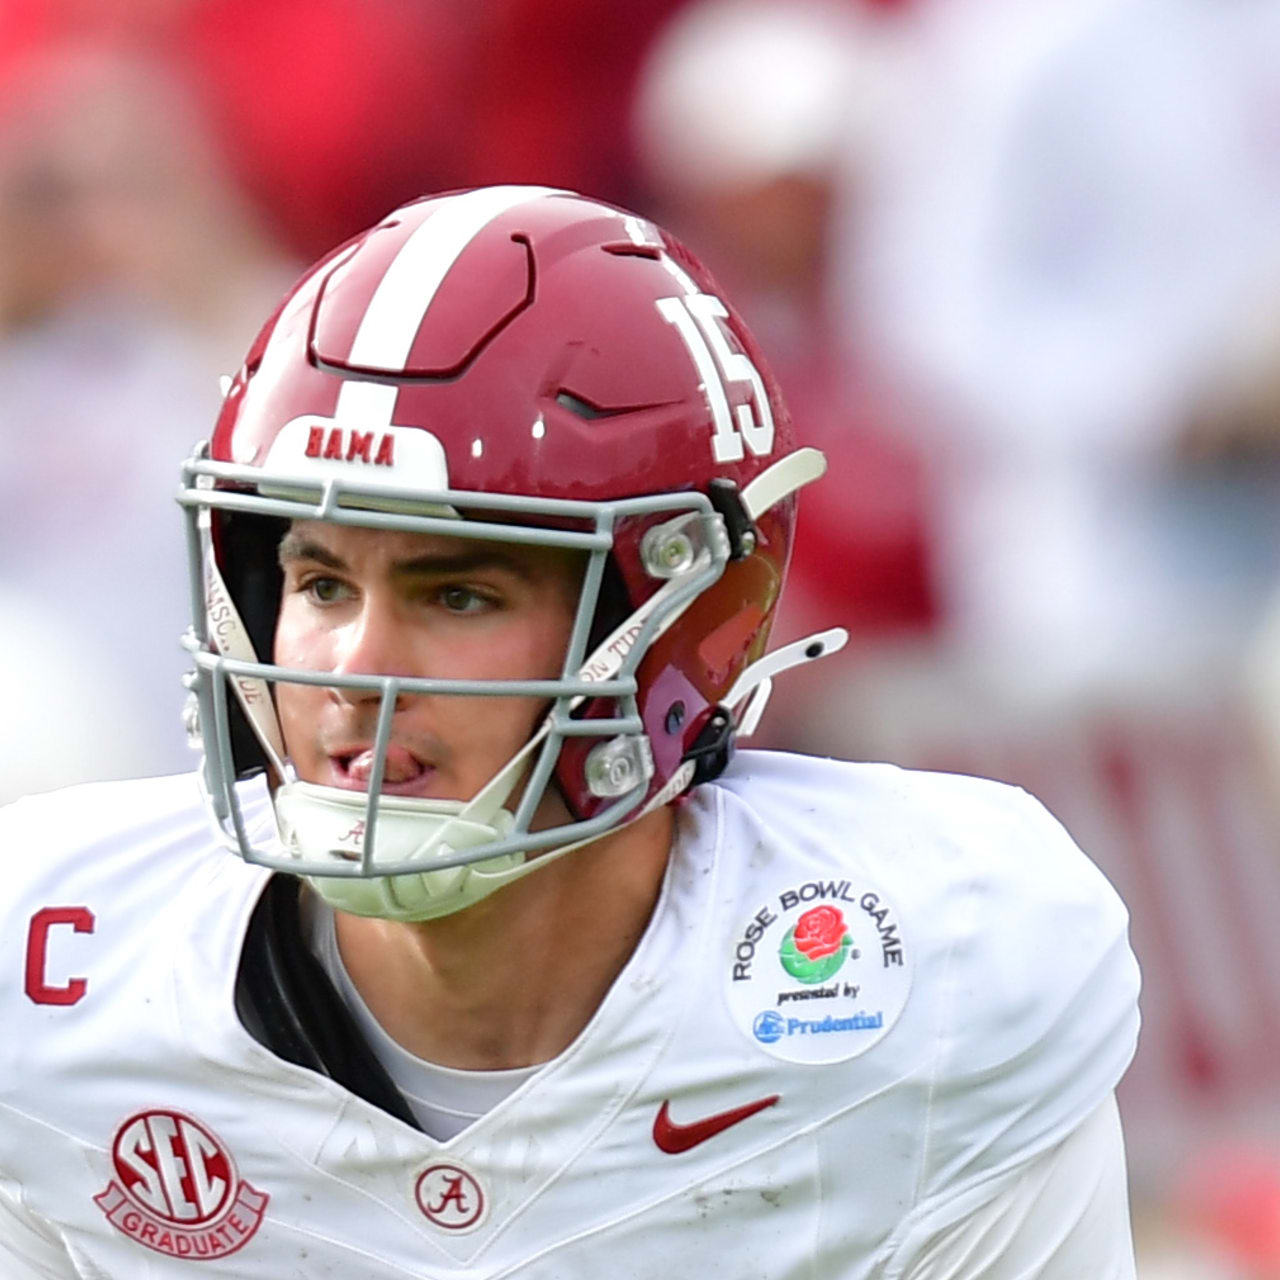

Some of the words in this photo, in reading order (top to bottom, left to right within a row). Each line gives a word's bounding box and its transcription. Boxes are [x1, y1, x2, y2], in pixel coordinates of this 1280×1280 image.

[655, 293, 775, 463] 15
[304, 425, 396, 467] BAMA
[24, 906, 95, 1006] C
[732, 906, 779, 982] ROSE
[778, 880, 856, 912] BOWL
[859, 892, 904, 968] GAME
[777, 982, 840, 1006] presented
[843, 981, 860, 999] by
[787, 1010, 883, 1036] Prudential
[117, 1114, 228, 1221] SEC
[122, 1212, 251, 1256] GRADUATE
